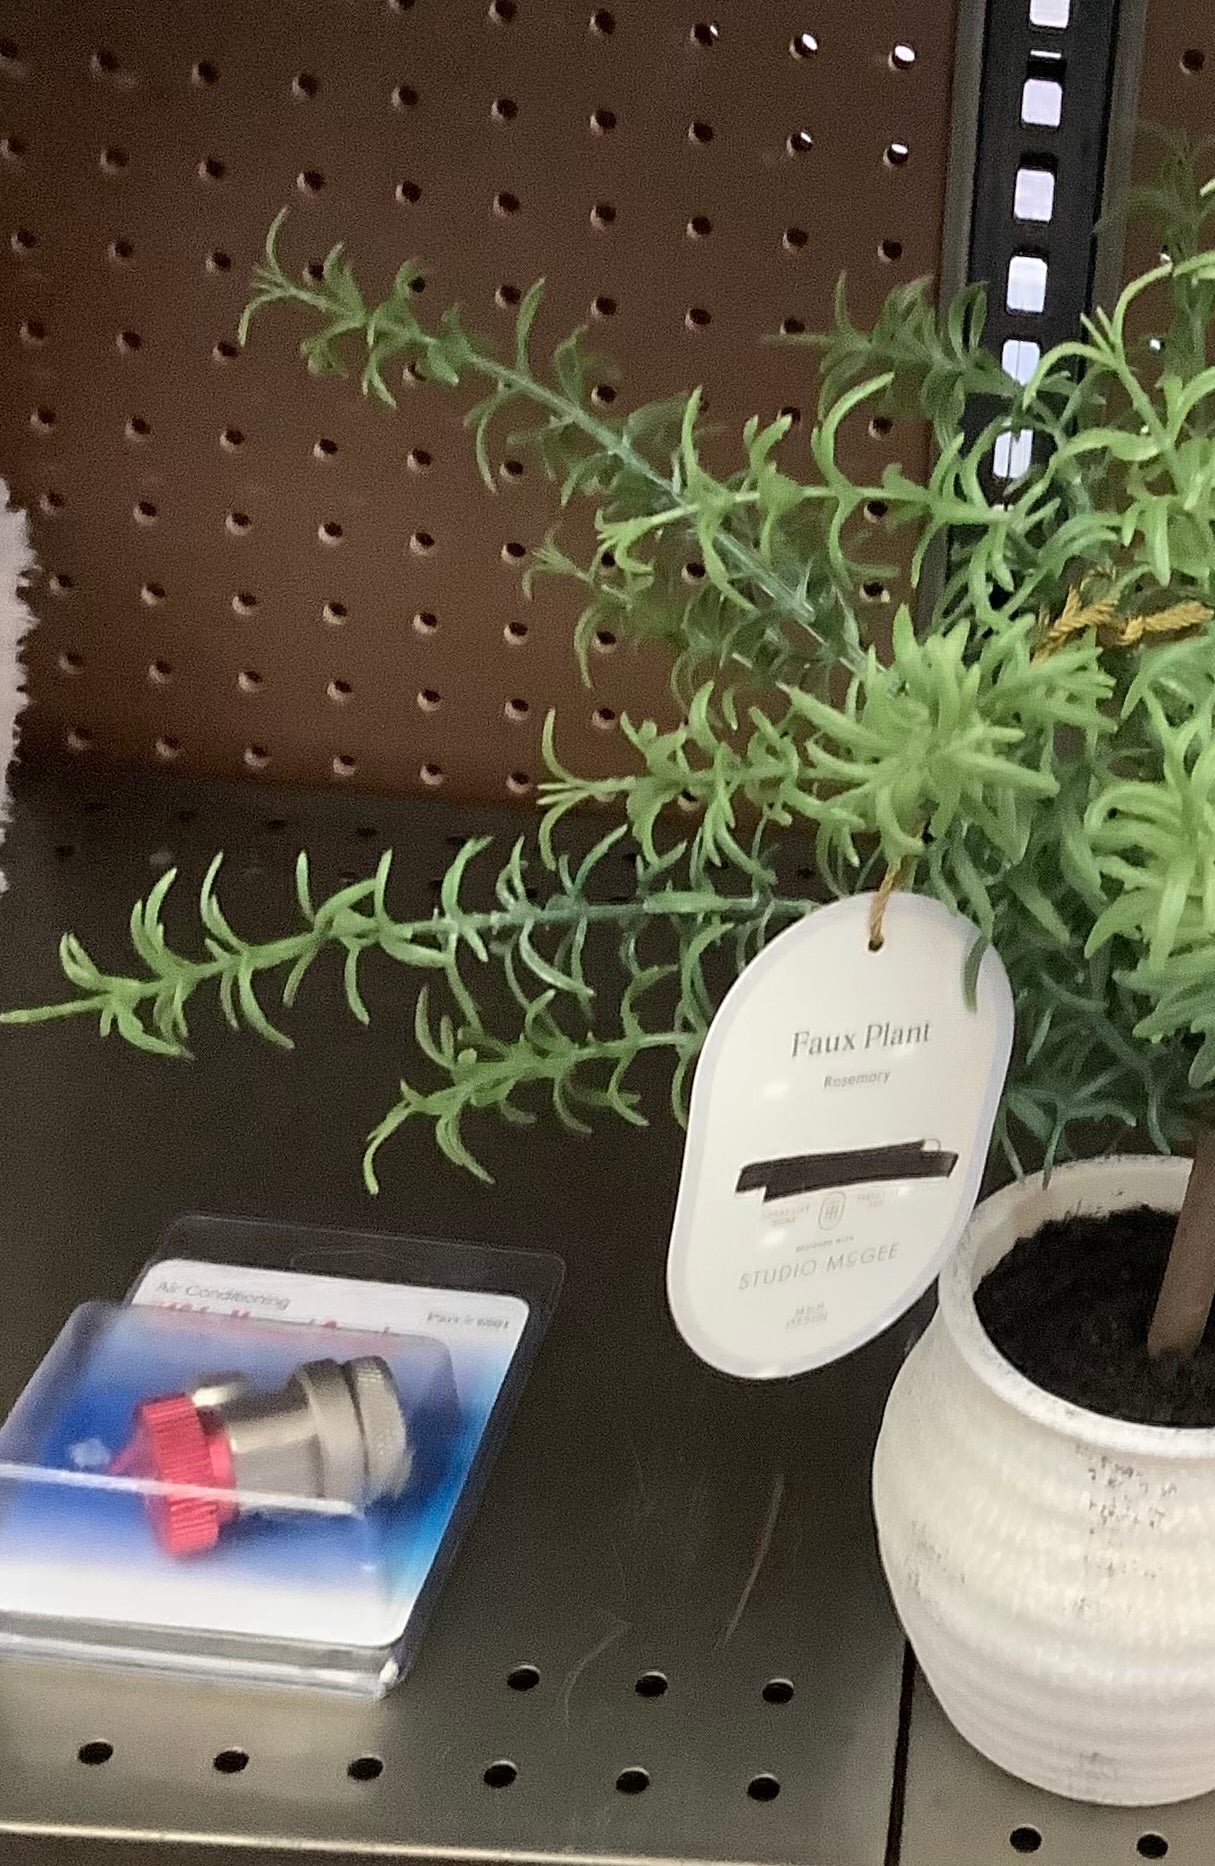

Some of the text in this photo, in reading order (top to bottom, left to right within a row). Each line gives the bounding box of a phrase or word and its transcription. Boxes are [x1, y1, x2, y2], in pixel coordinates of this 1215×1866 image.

[791, 1020, 933, 1058] Faux Plant
[823, 1070, 891, 1089] Rosemary
[738, 1258, 817, 1290] STUDIO
[156, 1279, 291, 1311] Air Conditioning
